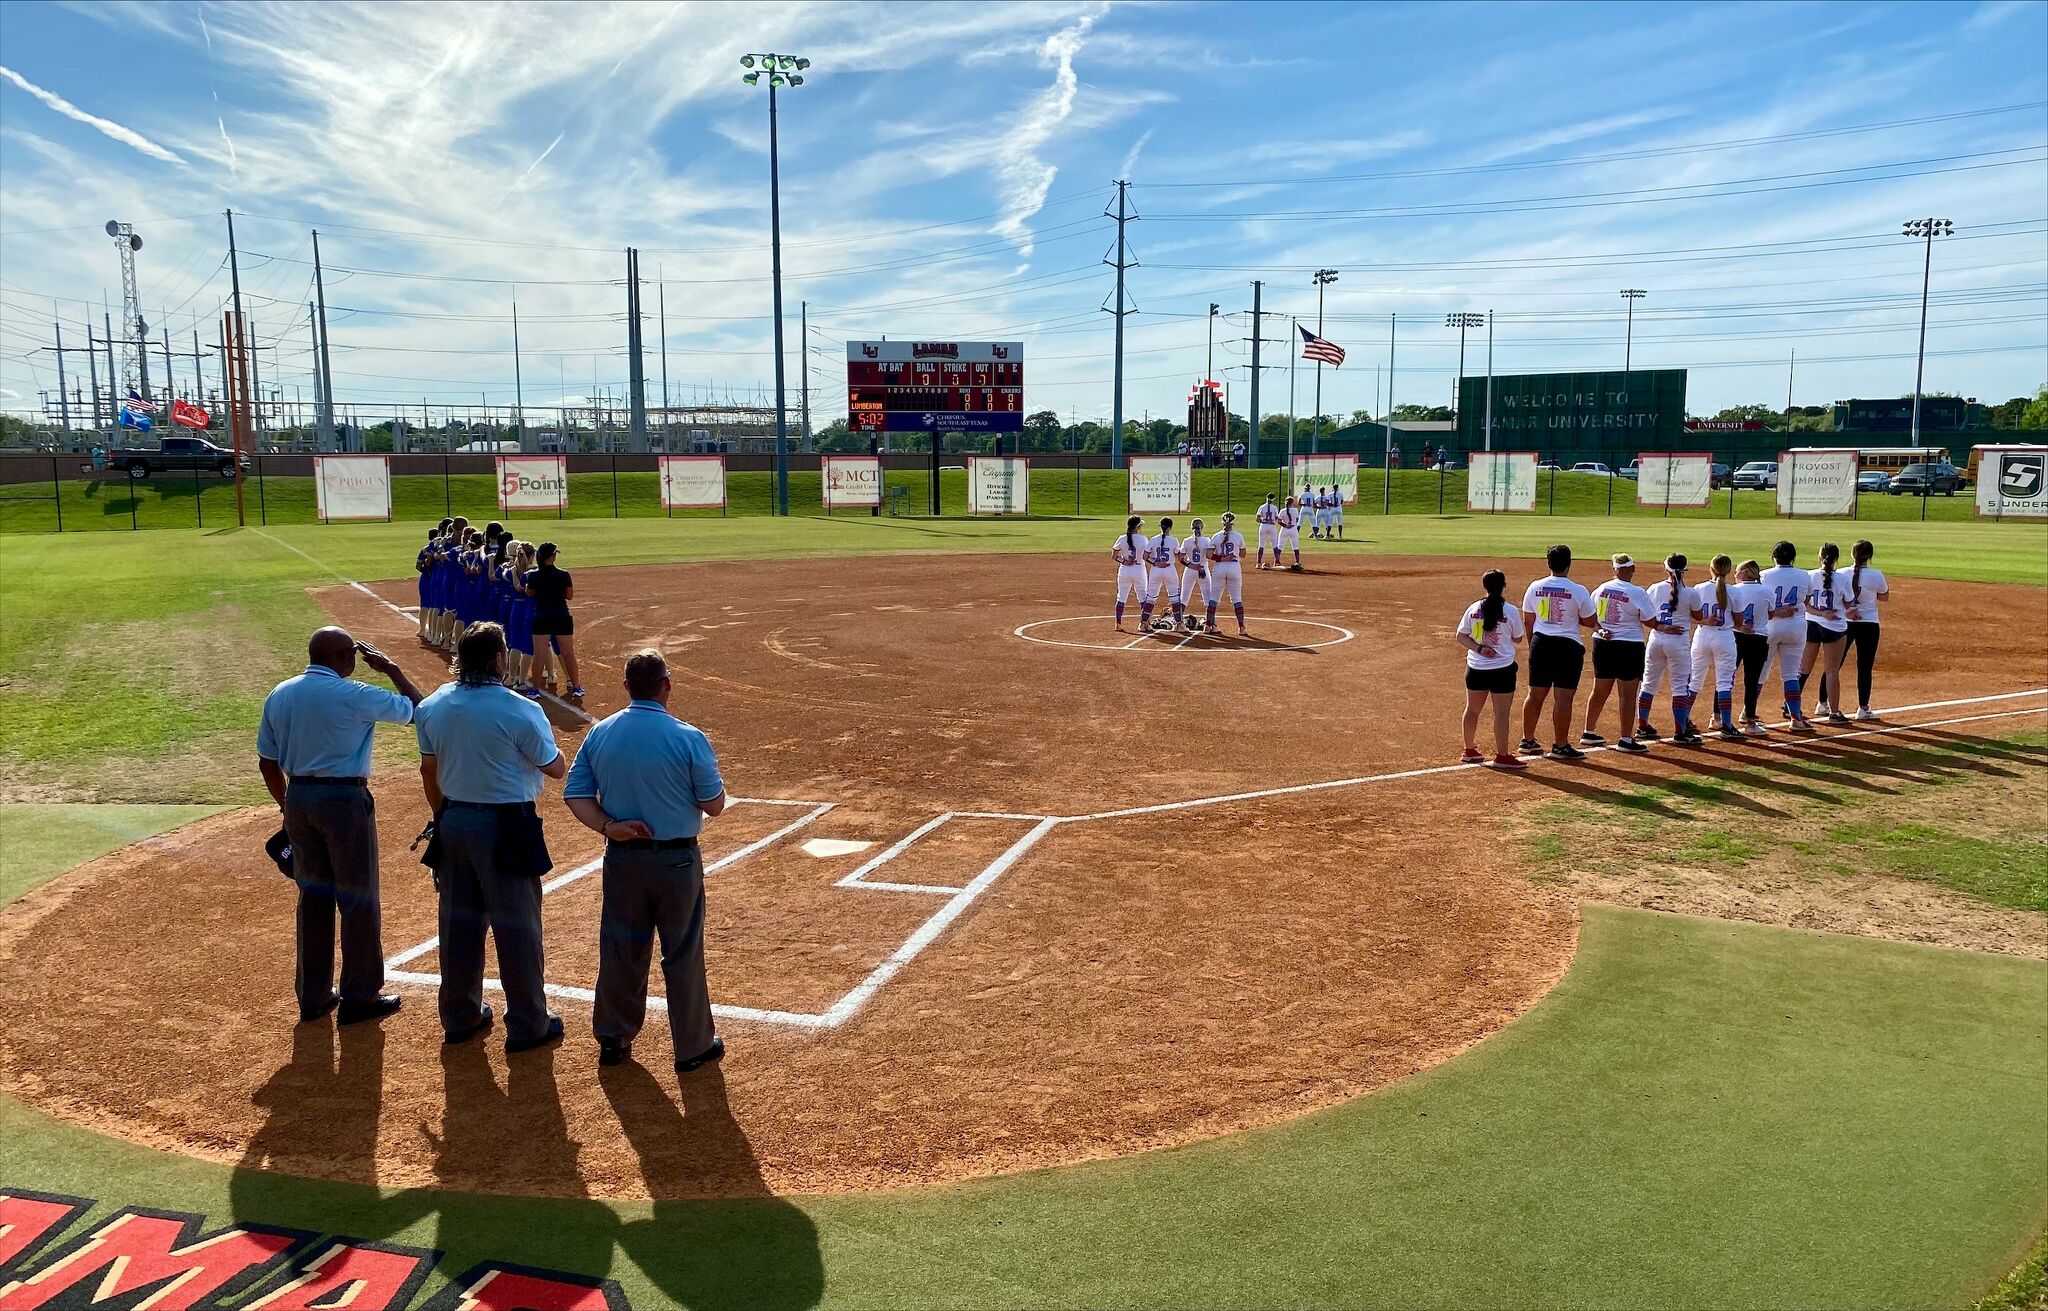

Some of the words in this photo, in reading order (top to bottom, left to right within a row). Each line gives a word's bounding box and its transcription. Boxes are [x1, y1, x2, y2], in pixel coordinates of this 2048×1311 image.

[912, 343, 958, 355] LAMAR
[878, 363, 887, 372] AT
[889, 363, 904, 372] BAT
[916, 363, 935, 372] BALL
[944, 364, 966, 372] STRIKE
[976, 364, 989, 372] OUT
[998, 364, 1004, 372] H
[1013, 364, 1018, 372] E
[964, 394, 970, 402] 0
[987, 394, 993, 402] 0
[1008, 394, 1013, 402] 0
[1605, 392, 1628, 405] TO
[964, 403, 970, 411] 0
[987, 403, 993, 411] 0
[1008, 403, 1013, 411] 0
[859, 413, 883, 424] 5:02
[1480, 416, 1537, 429] LAMR
[1549, 414, 1659, 428] UNIVERSITY
[846, 470, 880, 482] MCT
[1295, 473, 1355, 486] TERMINIX
[1156, 547, 1170, 562] 15
[1193, 548, 1201, 562] 6
[1775, 586, 1798, 608] 14
[1660, 603, 1673, 625] 2
[1701, 603, 1725, 626] 10
